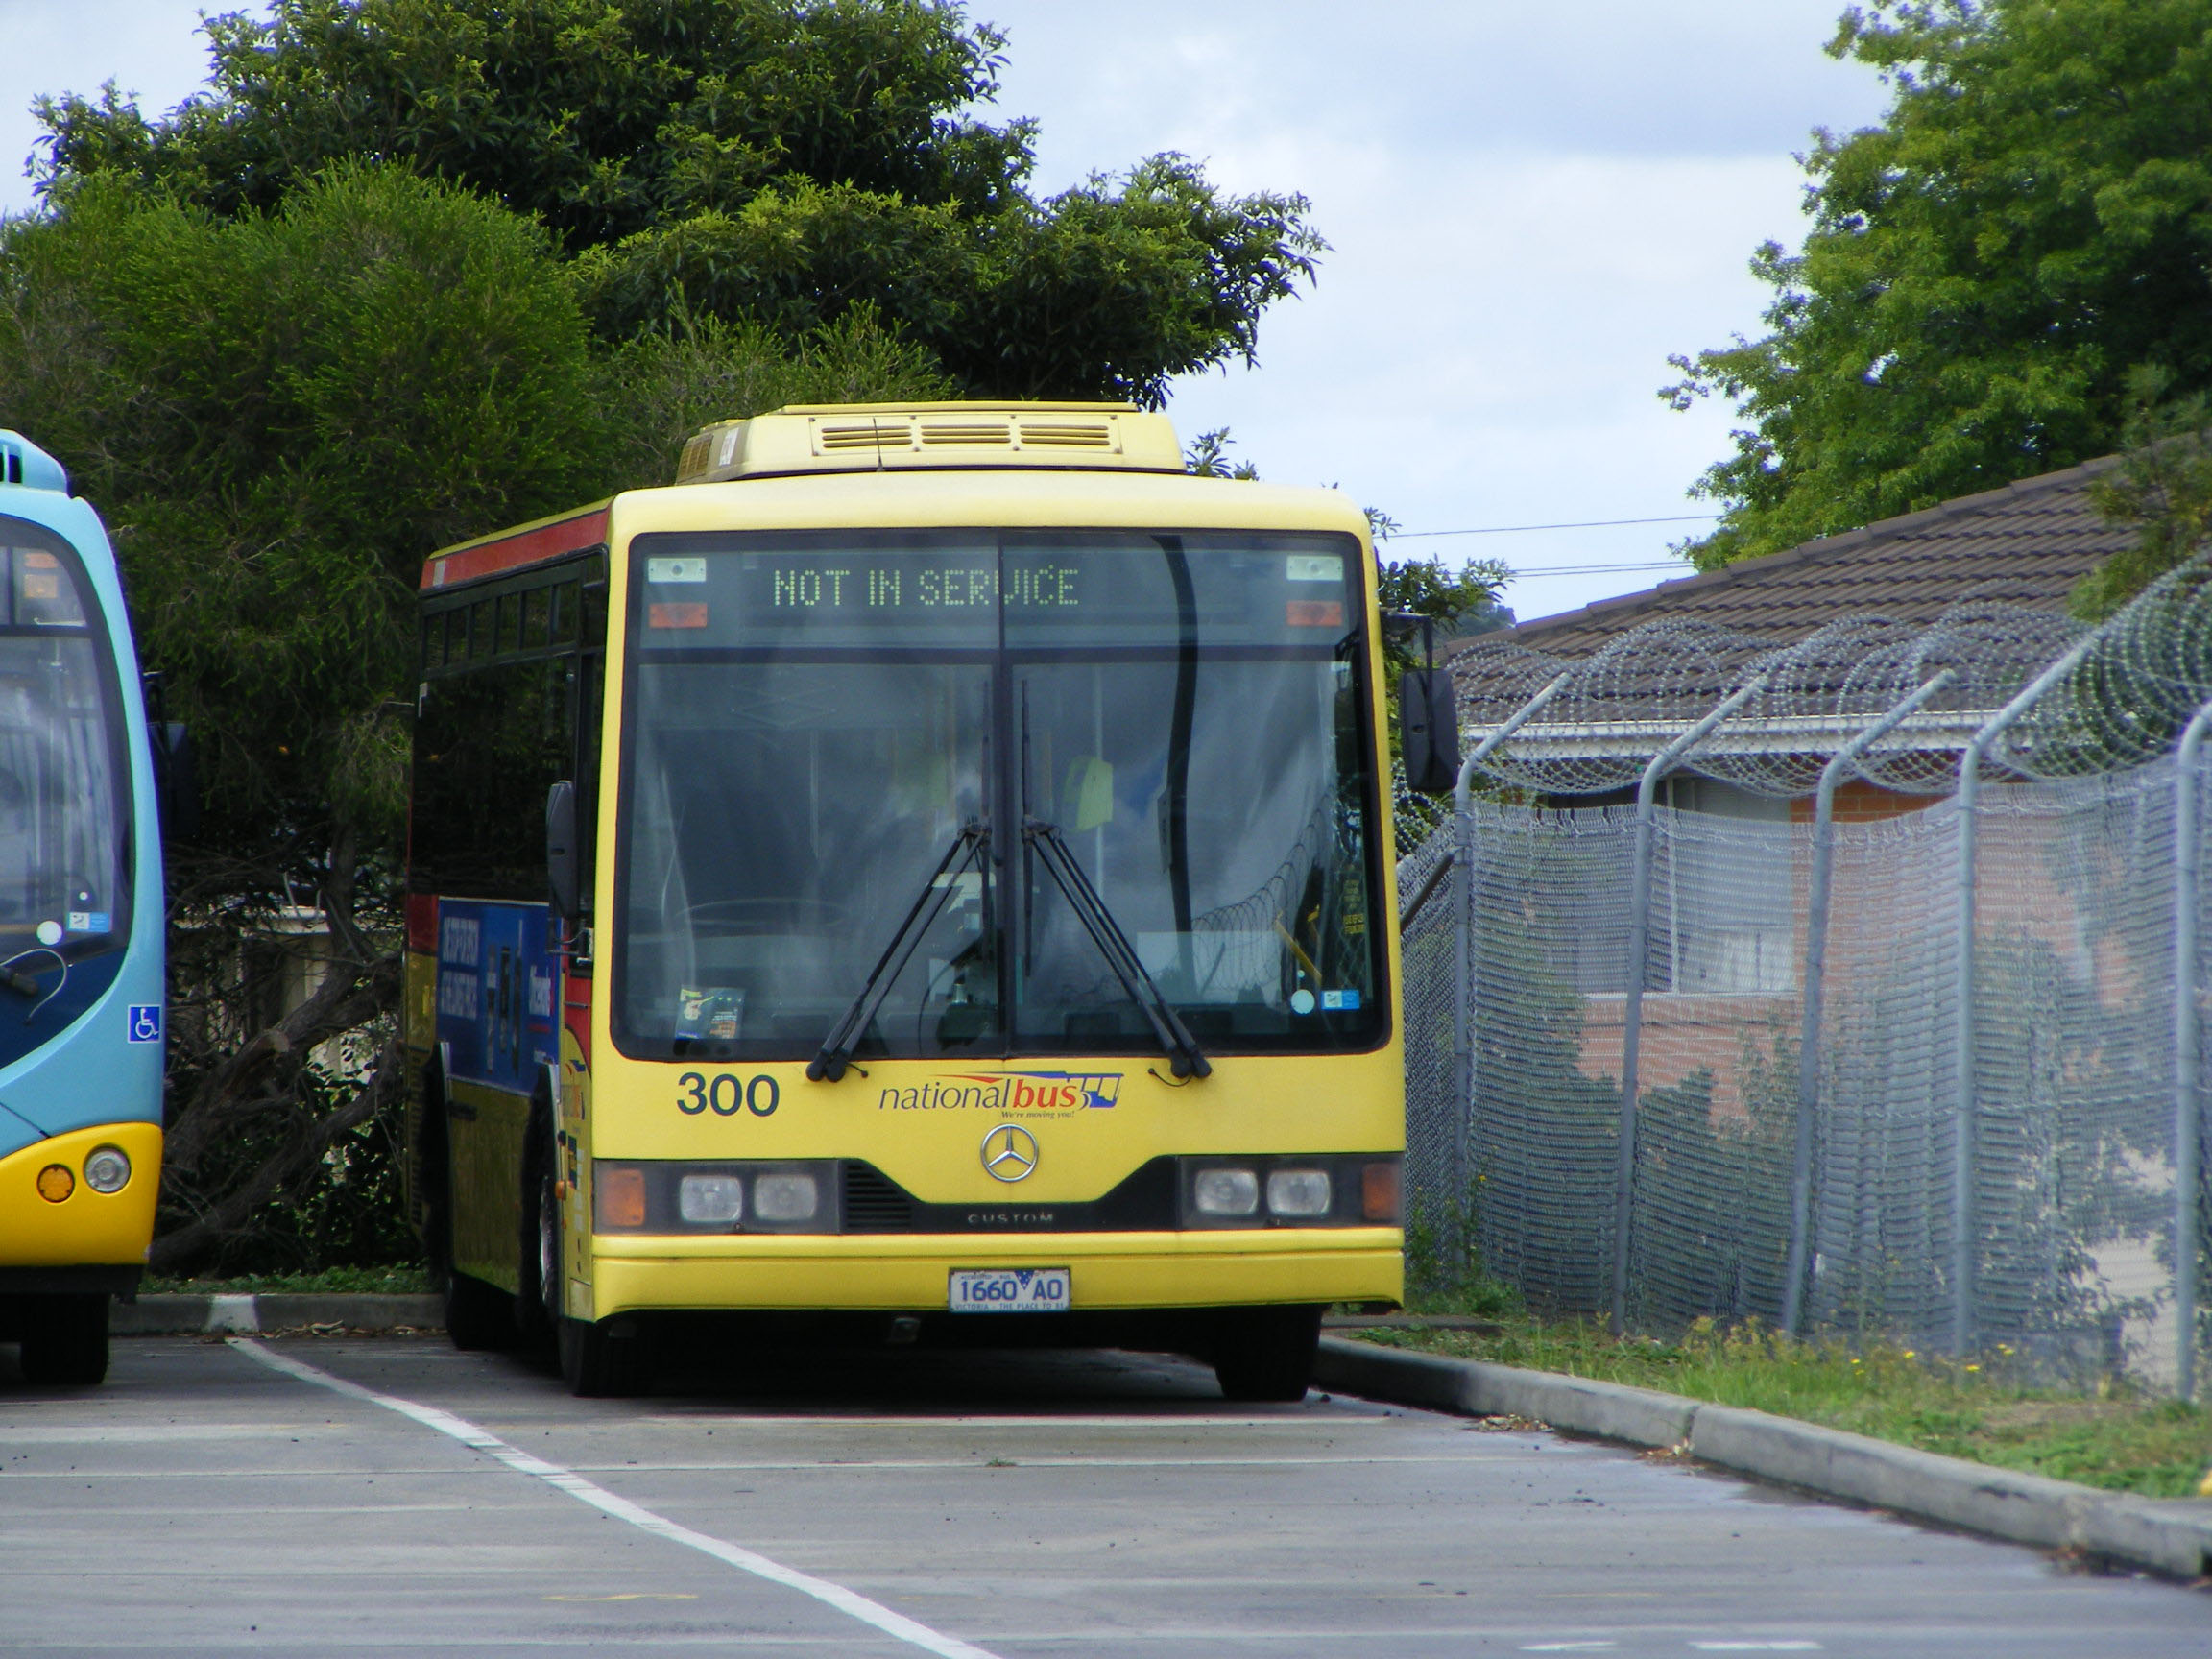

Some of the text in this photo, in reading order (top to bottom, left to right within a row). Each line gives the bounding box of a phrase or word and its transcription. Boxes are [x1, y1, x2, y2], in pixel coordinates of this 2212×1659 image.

[775, 568, 1079, 606] NOT IN SERVICE
[676, 1071, 781, 1118] 300
[1026, 1111, 1055, 1119] moving
[1057, 1111, 1075, 1119] you!
[968, 1214, 1054, 1223] CUSTOM
[960, 1280, 1018, 1301] 1660
